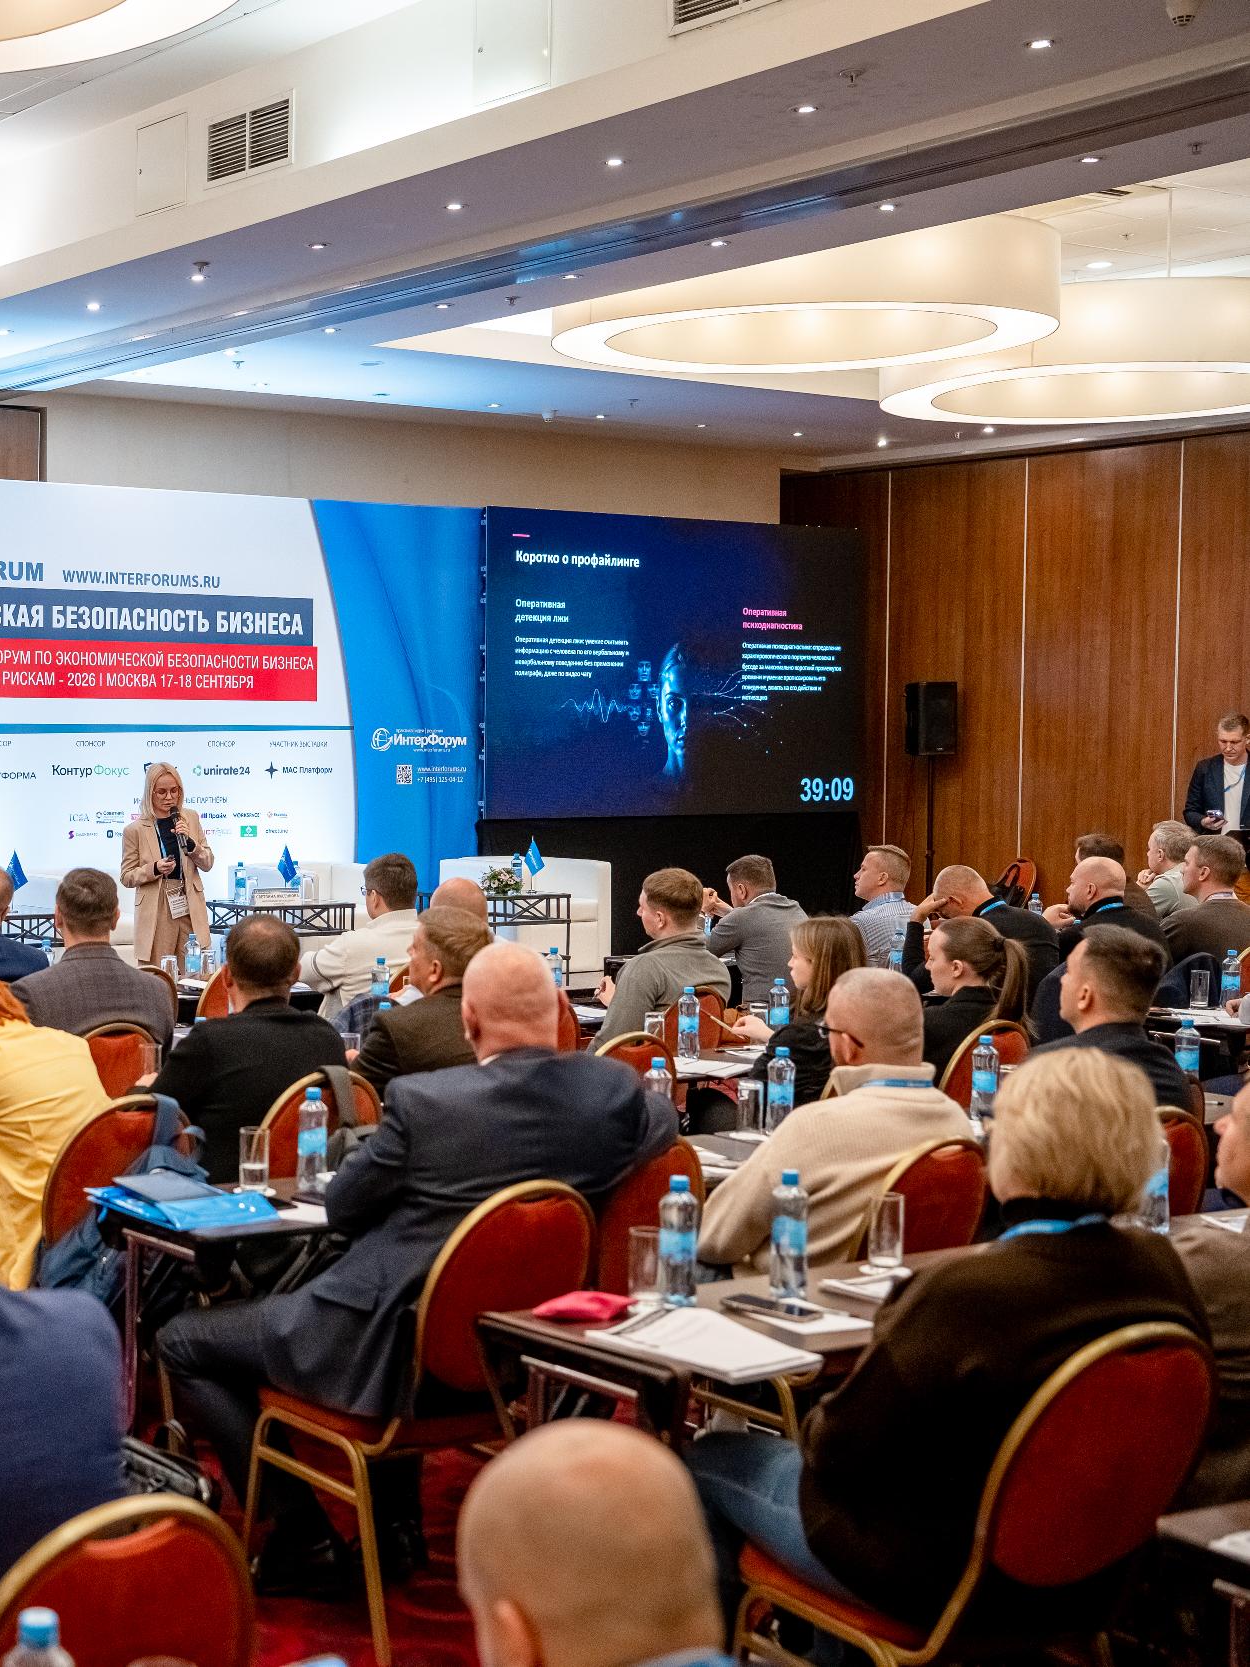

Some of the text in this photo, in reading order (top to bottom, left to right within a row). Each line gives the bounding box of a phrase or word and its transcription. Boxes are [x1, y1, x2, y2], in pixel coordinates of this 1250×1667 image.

[515, 550, 639, 569] Коротко о профайлинге
[62, 569, 221, 589] WWW.INTERFORUMS.RU
[515, 599, 566, 609] Оперативная
[52, 605, 210, 633] БЕЗОПАСНОСТЬ
[216, 609, 304, 636] БИЗНЕСА
[515, 614, 569, 624] детекция лжи
[743, 608, 787, 617] Оперативная
[742, 622, 803, 631] психодиагностика
[34, 650, 52, 666] ПО
[55, 649, 164, 669] ЭКОНОМИЧЕСКОЙ
[167, 653, 260, 669] БЕЗОПАСНОСТИ
[262, 655, 315, 671] БИЗНЕСА
[2, 670, 56, 687] РИСКАМ
[67, 671, 97, 687] 2026
[106, 672, 157, 688] МОСКВА
[160, 673, 193, 688] 17-18
[195, 673, 254, 689] СЕНТЯБРЯ
[394, 733, 467, 749] ИнтерФорум
[52, 764, 130, 778] Контур Фокус
[203, 765, 251, 776] unirate24
[800, 777, 855, 802] 39:09
